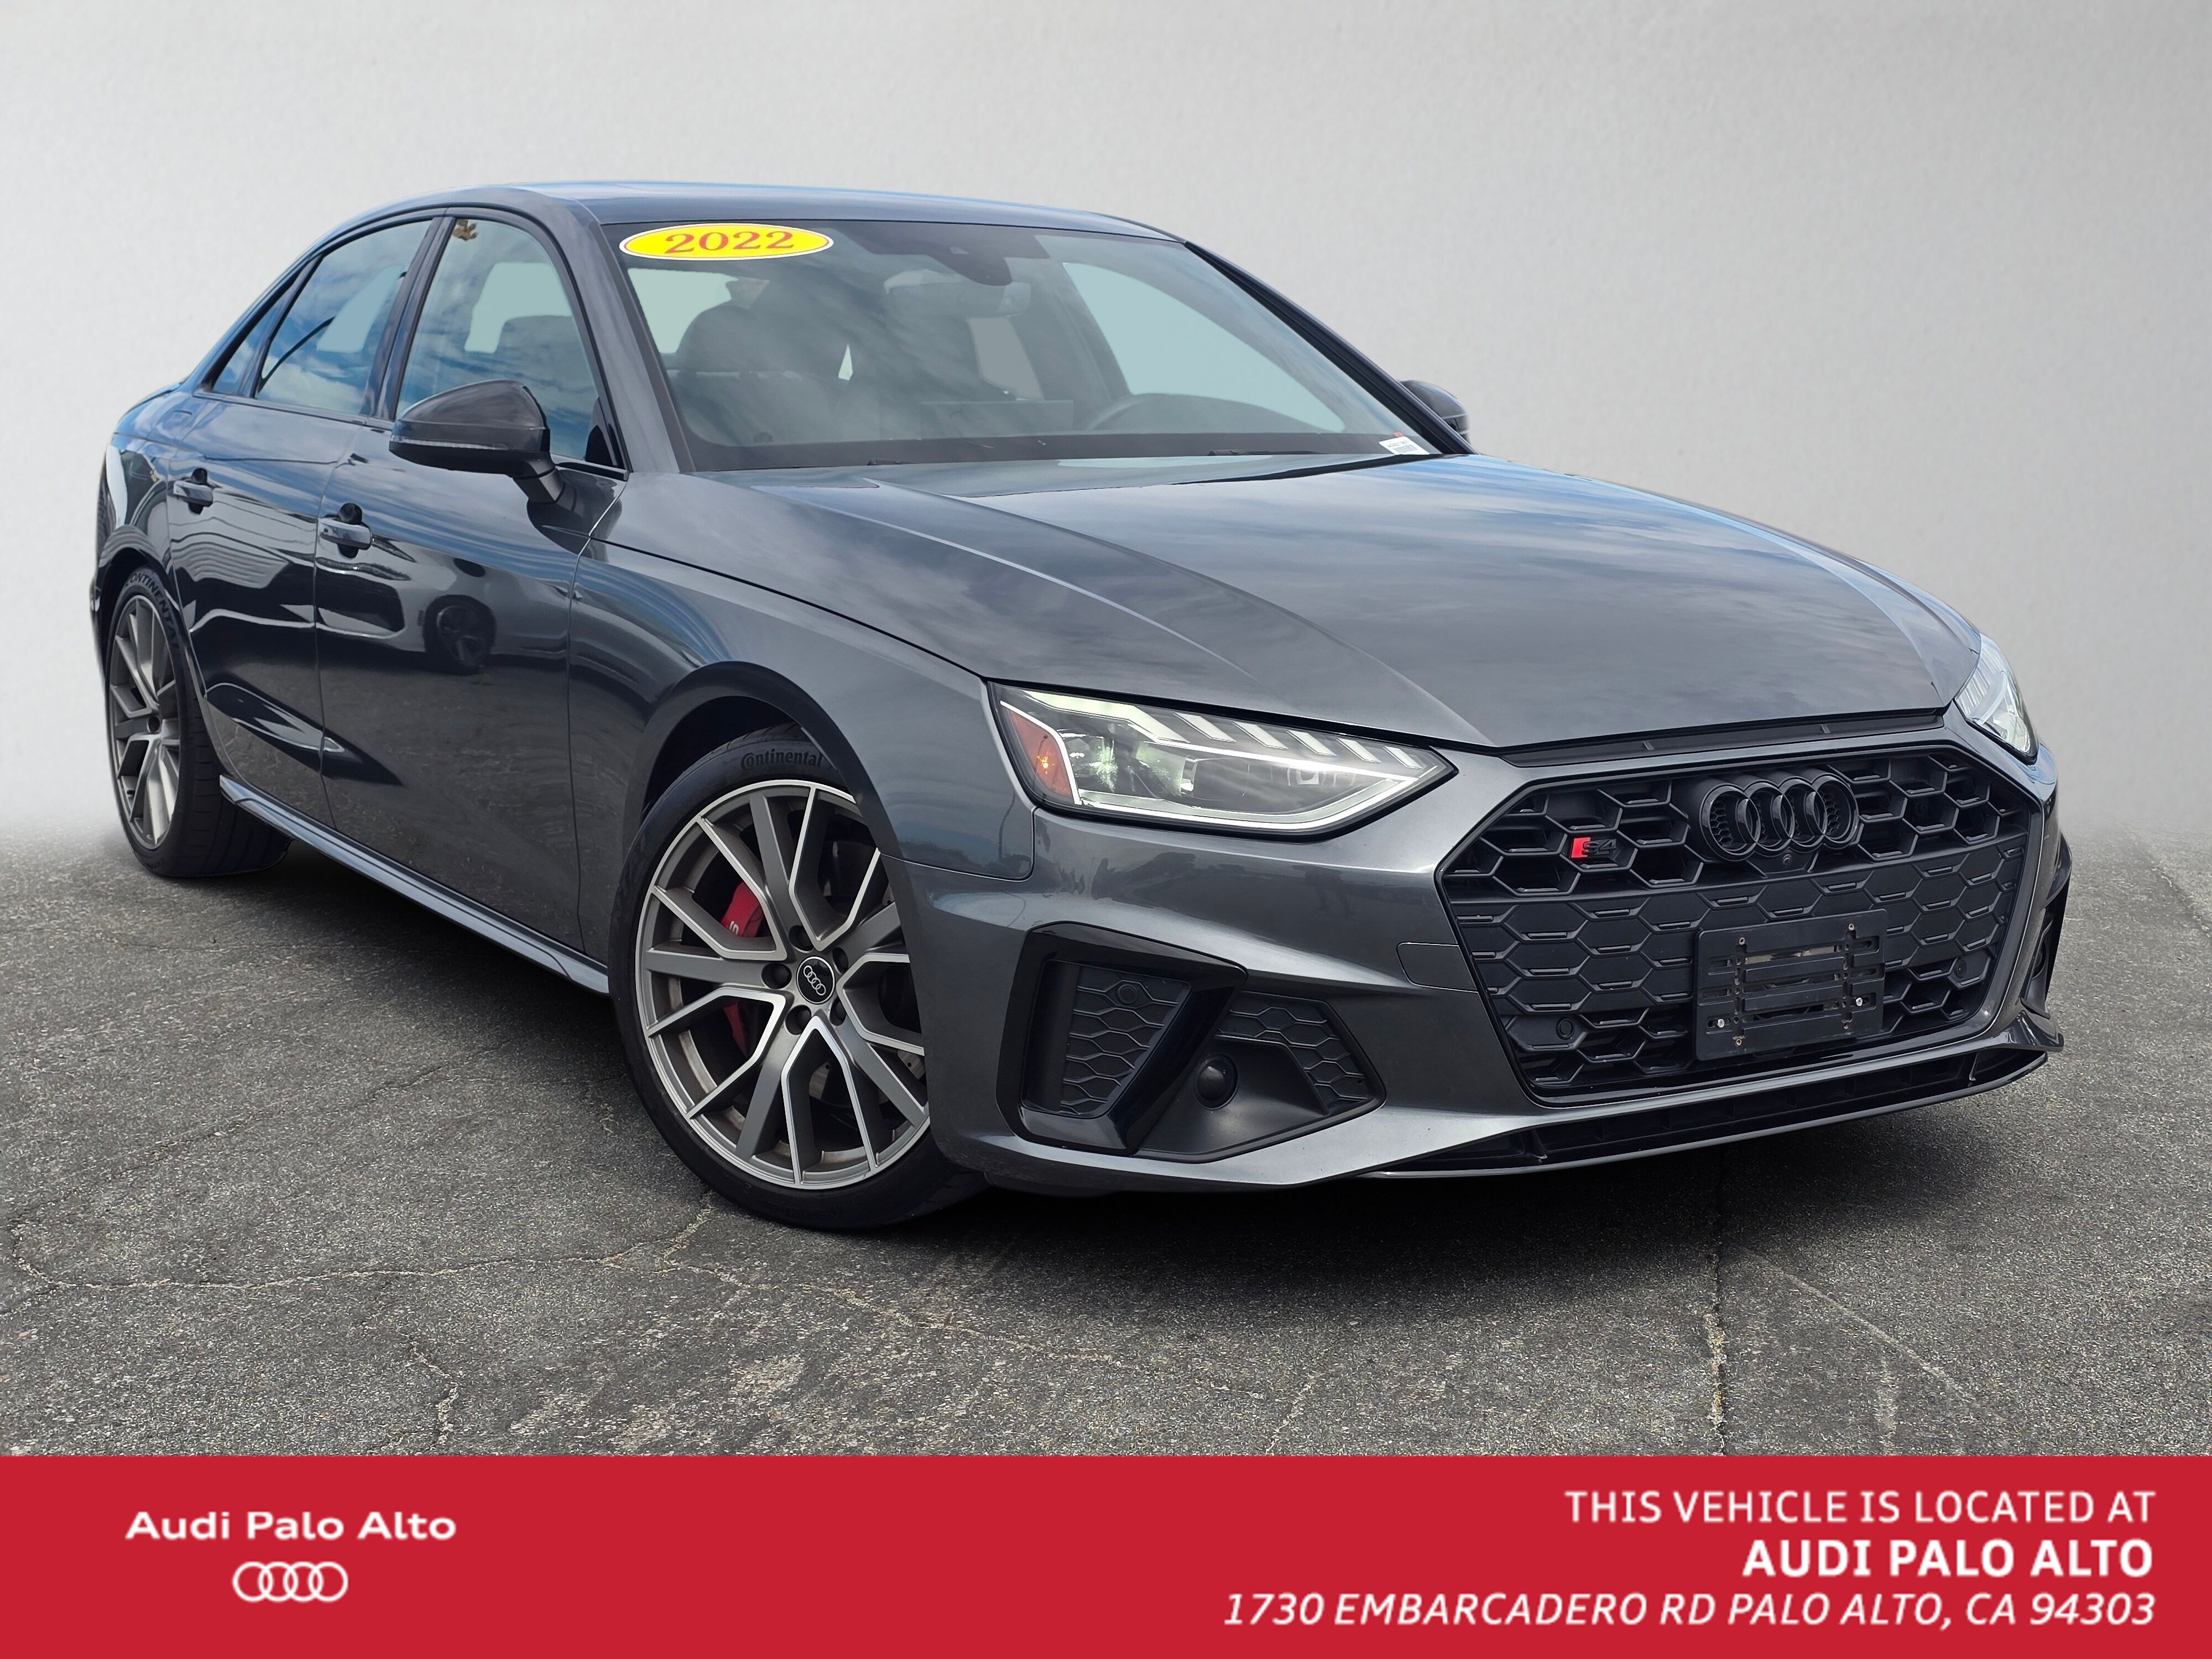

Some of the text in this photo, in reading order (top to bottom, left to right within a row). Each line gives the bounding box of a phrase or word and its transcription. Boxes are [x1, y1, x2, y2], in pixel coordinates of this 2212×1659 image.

[665, 231, 794, 254] 2022
[740, 748, 823, 770] Continental
[1579, 838, 1617, 856] S4
